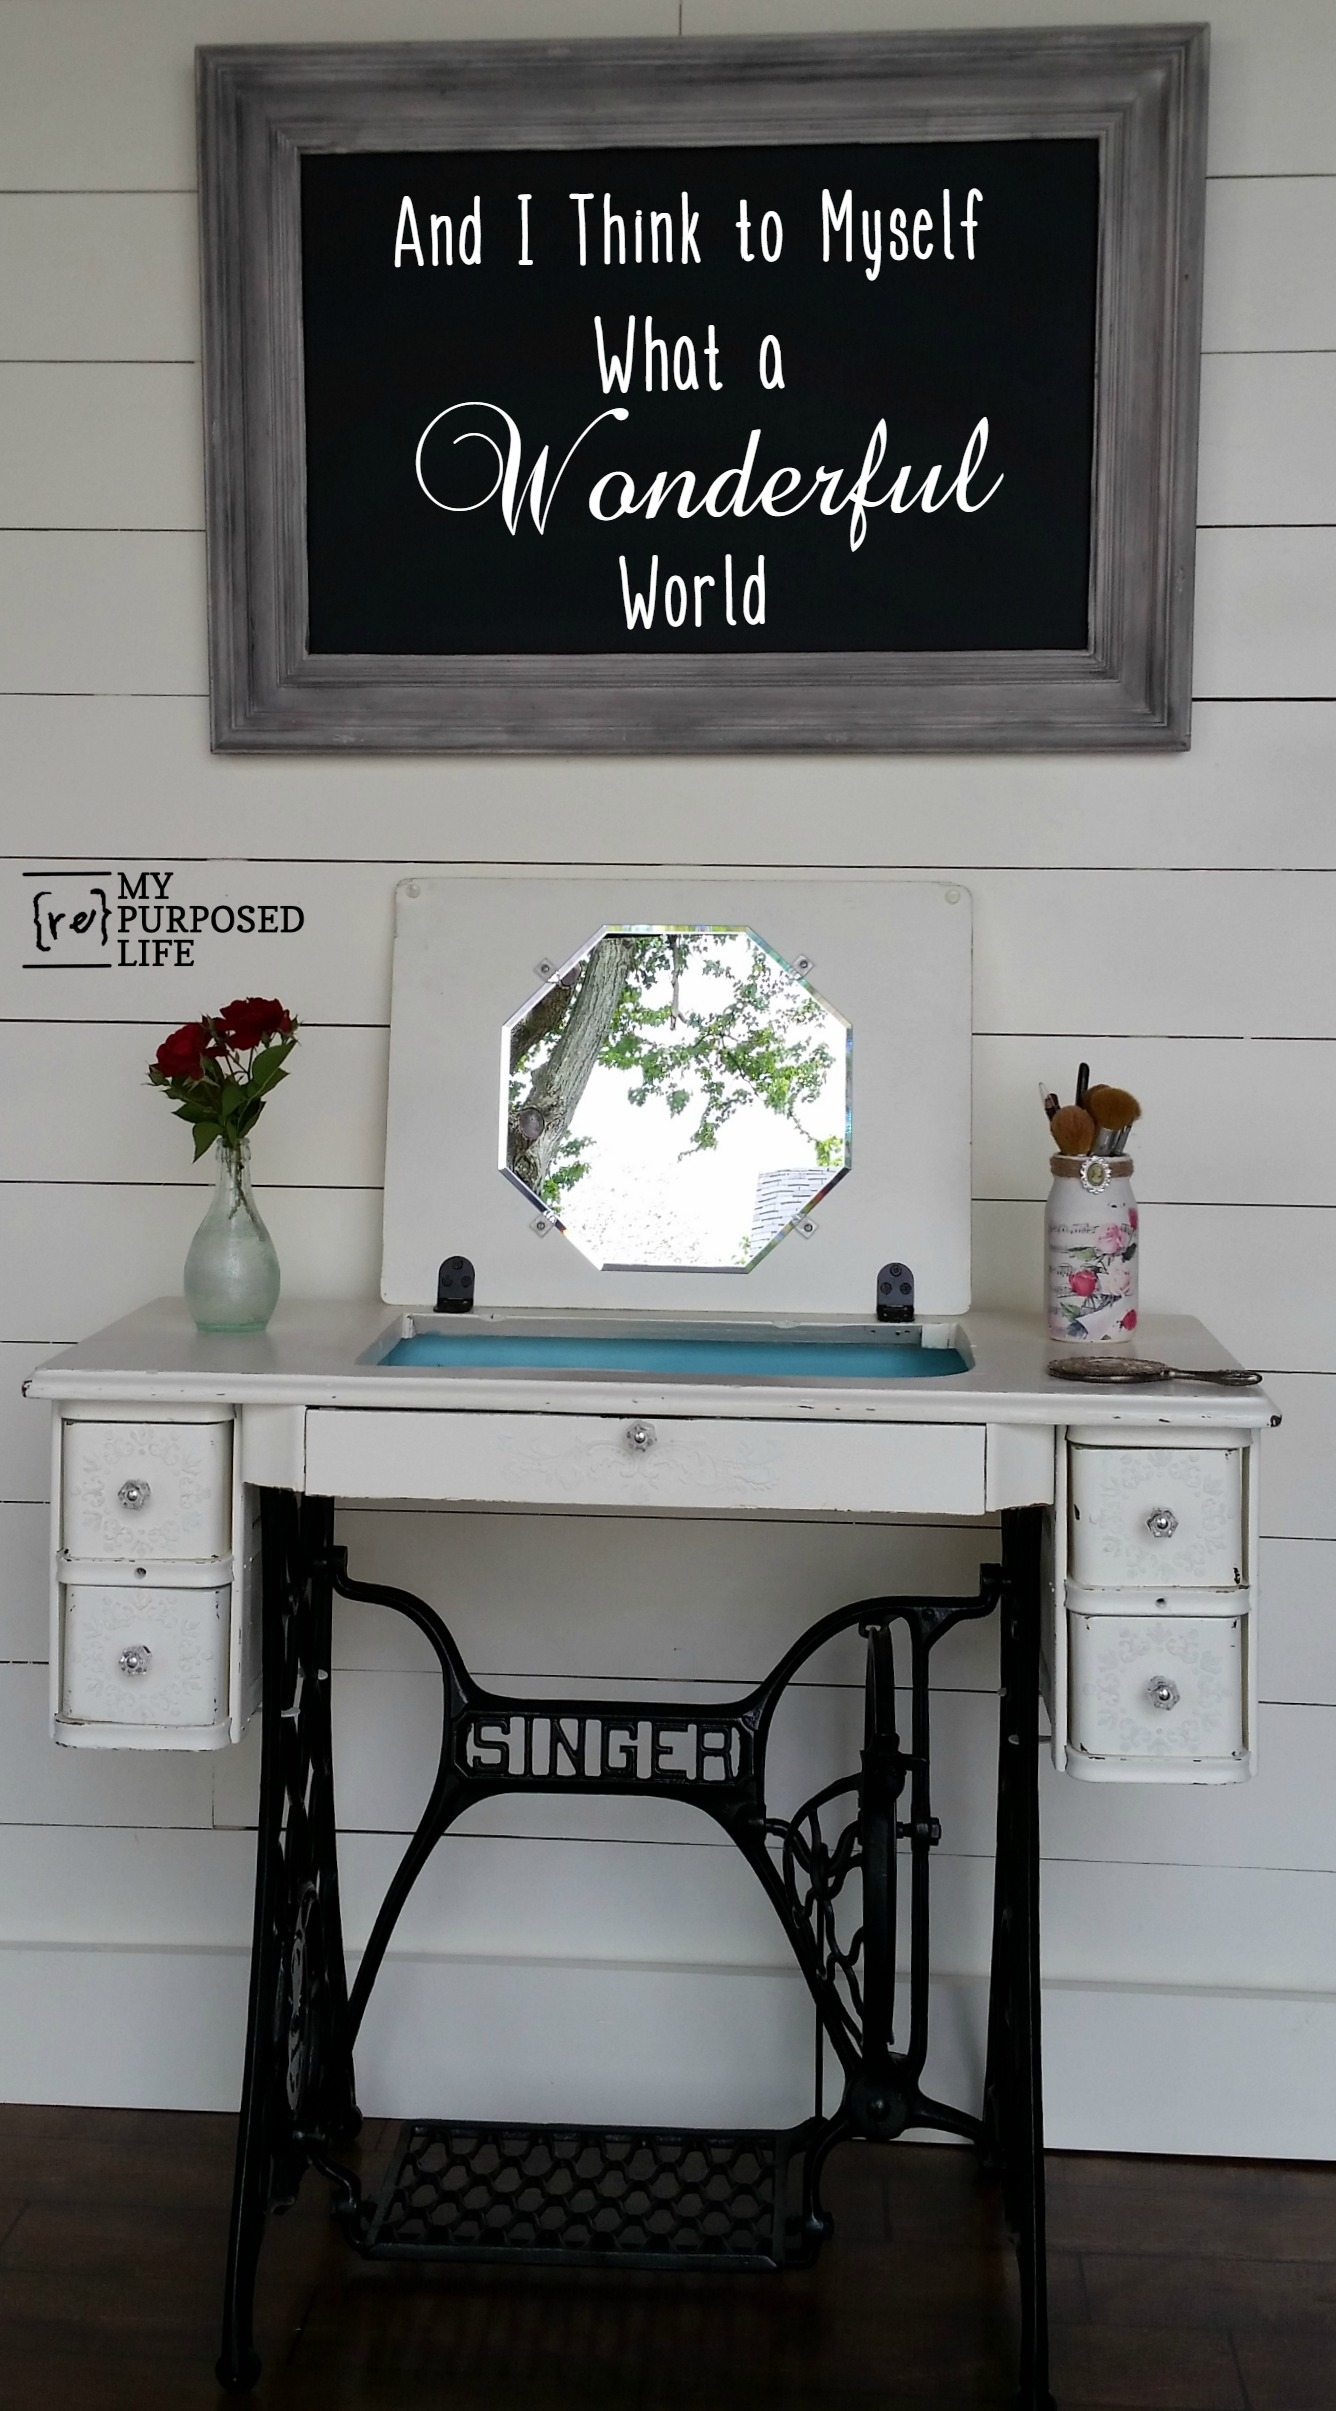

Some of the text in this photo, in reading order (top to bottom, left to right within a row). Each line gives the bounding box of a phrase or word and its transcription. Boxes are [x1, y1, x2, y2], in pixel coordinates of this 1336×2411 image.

[394, 187, 984, 282] And I Think to Myself
[593, 314, 786, 395] What a
[416, 402, 1005, 553] Wonderful
[618, 553, 766, 631] World
[470, 1714, 738, 1784] SINGER
